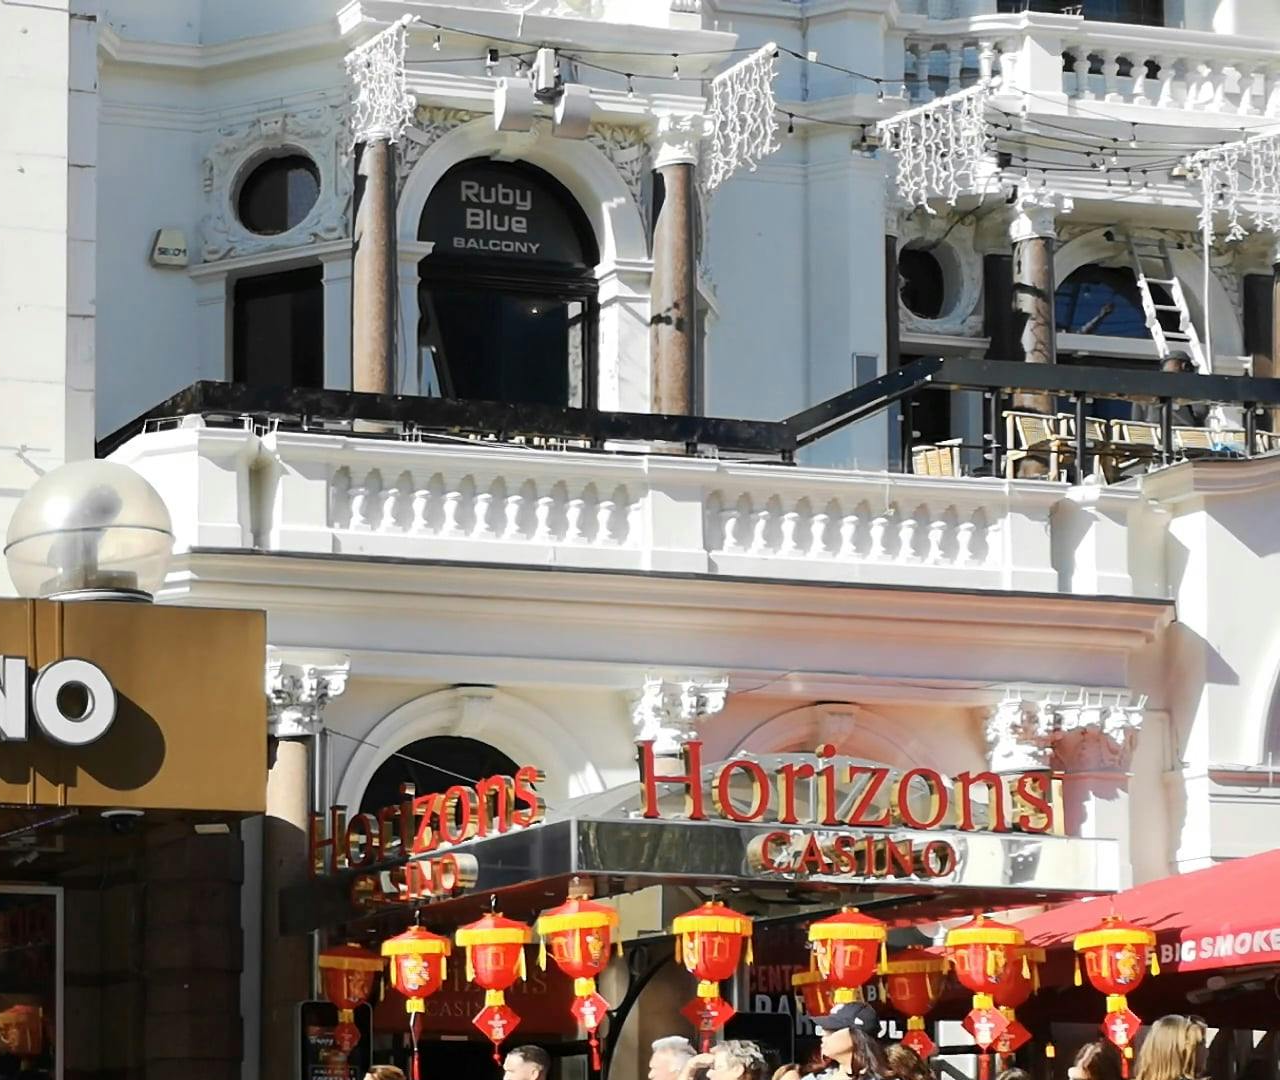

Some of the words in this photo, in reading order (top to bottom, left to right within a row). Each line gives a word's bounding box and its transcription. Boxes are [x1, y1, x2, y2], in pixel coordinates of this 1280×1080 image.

[460, 180, 532, 211] Ruby
[465, 208, 528, 234] Blue
[452, 236, 541, 255] BALCONY
[638, 740, 1055, 834] Horizons
[309, 764, 545, 881] Horizons
[753, 831, 957, 878] CASINO
[1160, 940, 1197, 965] BIG
